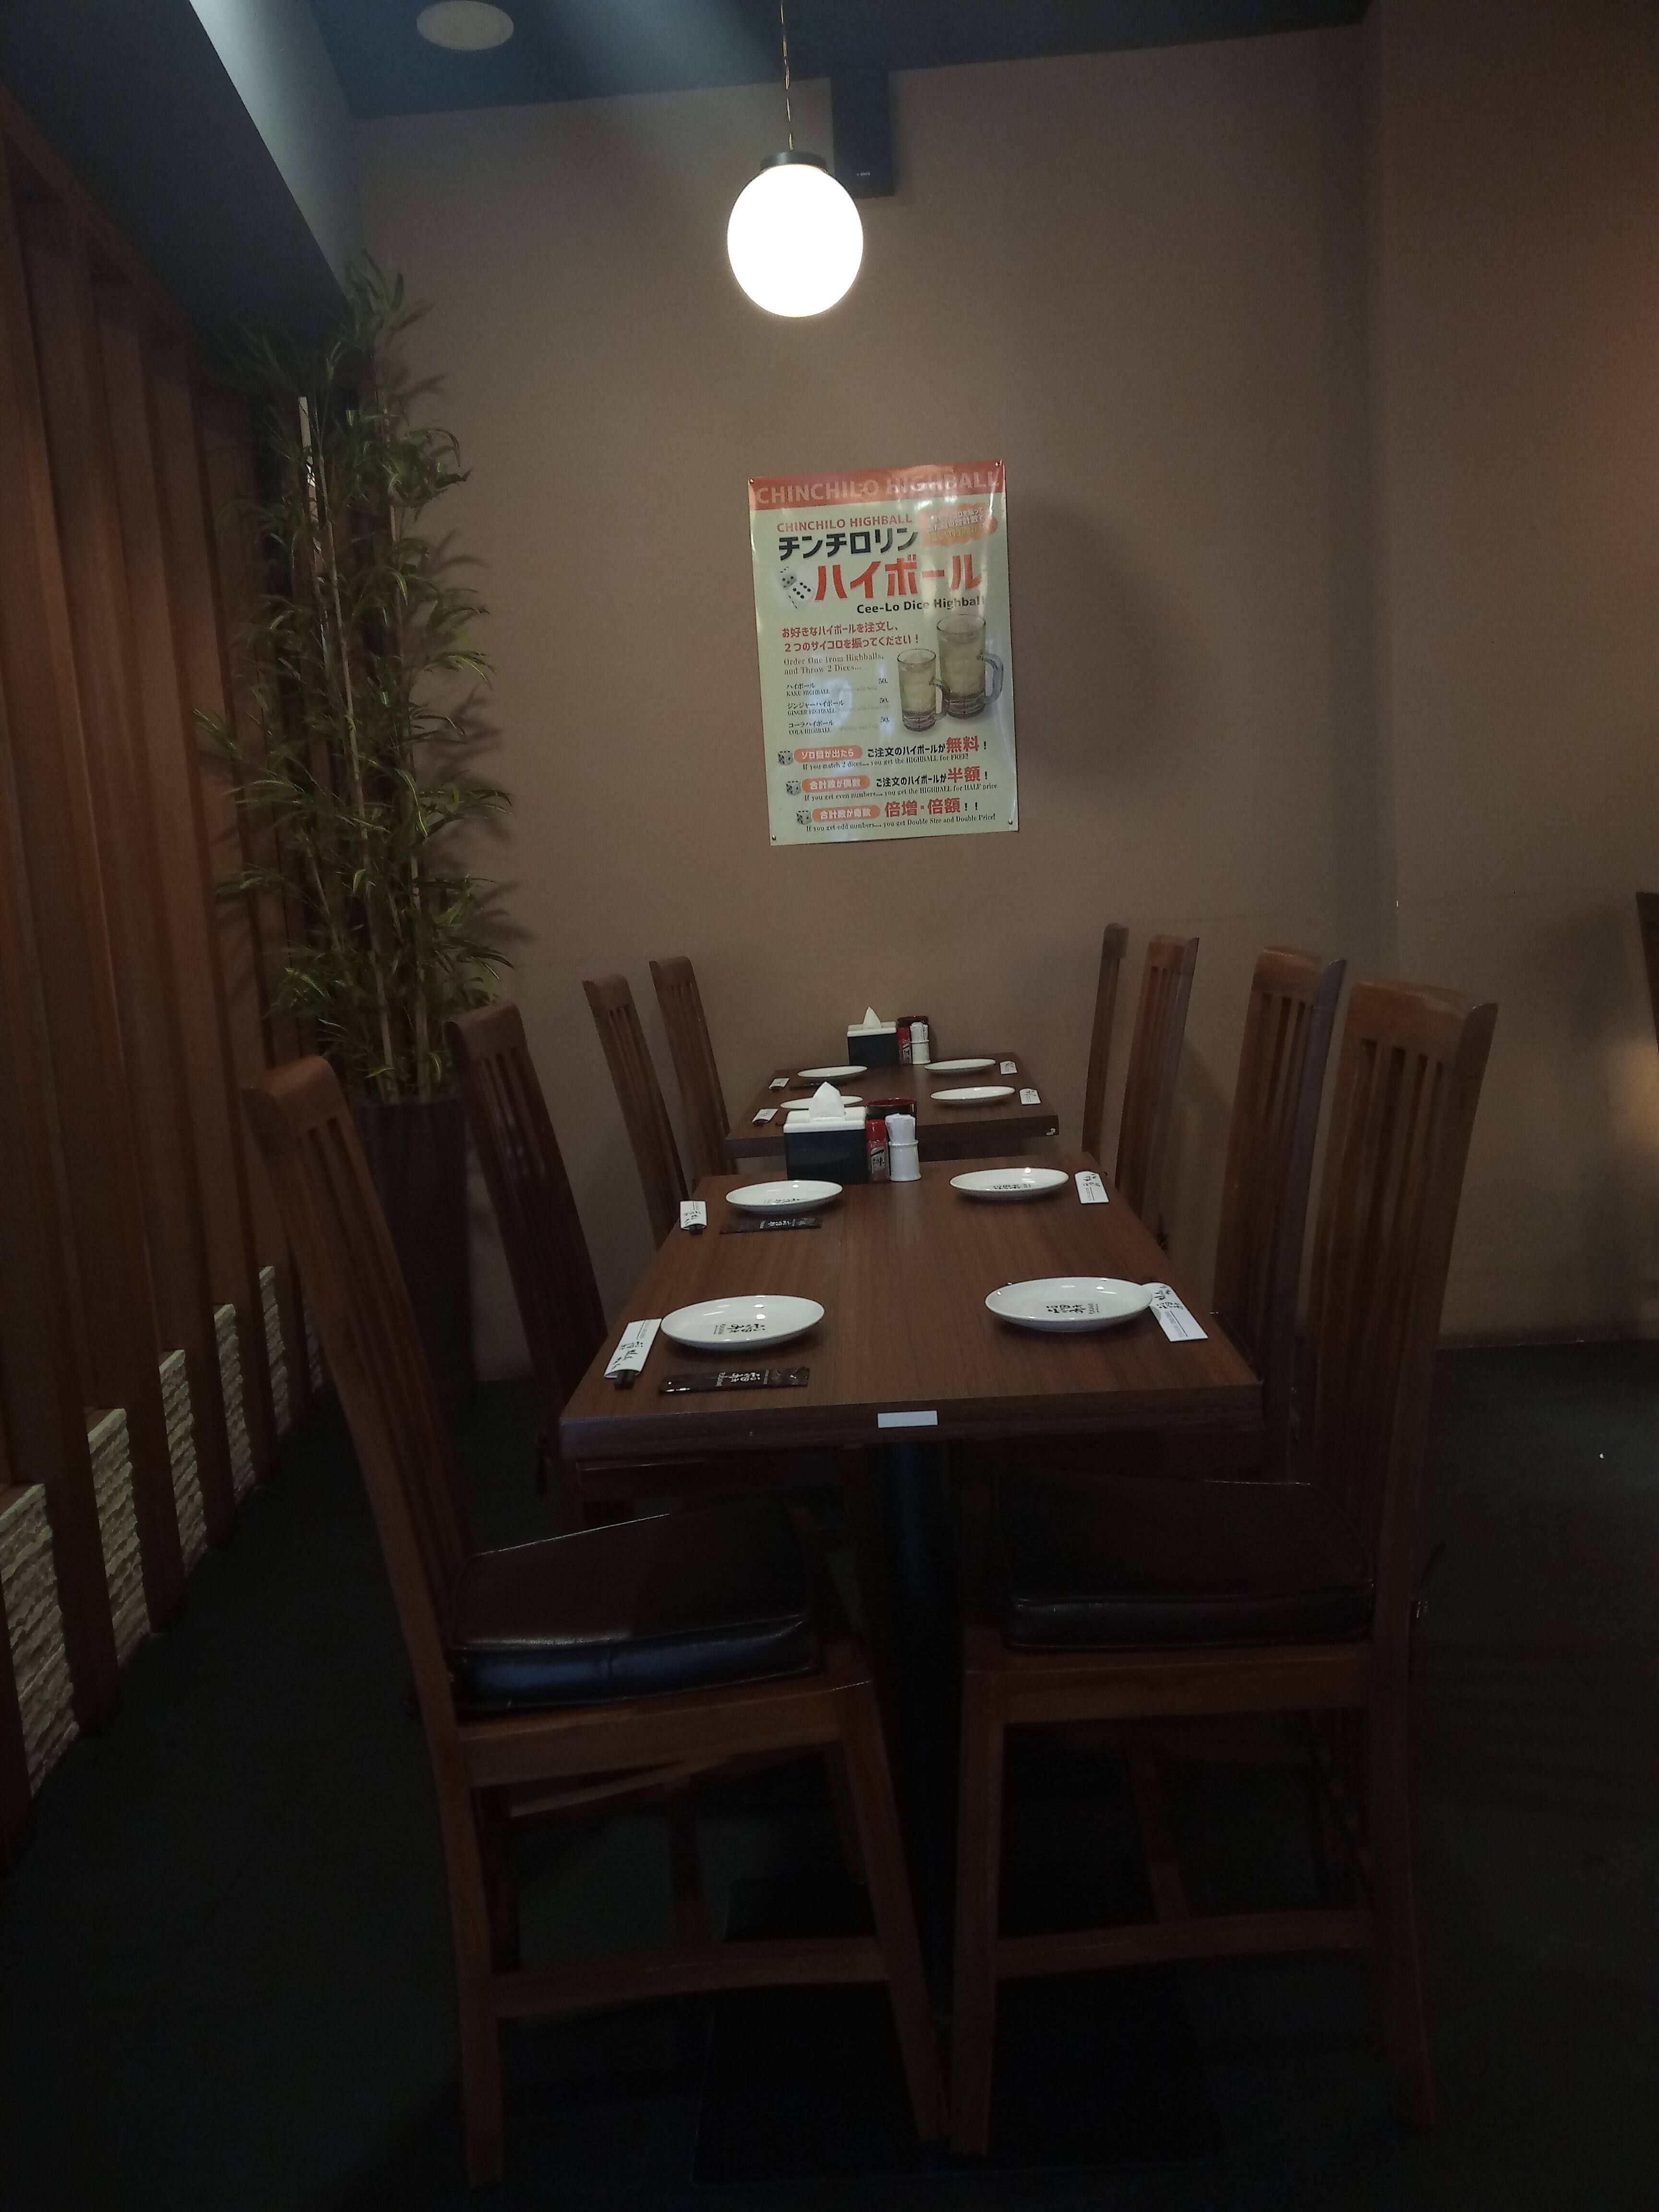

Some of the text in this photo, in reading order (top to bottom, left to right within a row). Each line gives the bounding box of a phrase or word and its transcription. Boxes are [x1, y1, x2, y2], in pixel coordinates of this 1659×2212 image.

[756, 479, 879, 505] CHINCHILO
[777, 514, 913, 532] CHINCHILO HIGHBALL
[779, 528, 918, 561] チンチロリン
[815, 554, 983, 601] ハイボール
[857, 601, 899, 614] Cee-Lo
[904, 600, 930, 610] Dice
[782, 621, 898, 637] お好きなハイボールを注文し、
[784, 657, 805, 666] Order
[788, 720, 834, 728] コーラハイボール
[906, 755, 938, 763] HIGHBALL
[920, 785, 951, 793] HIGHBALL
